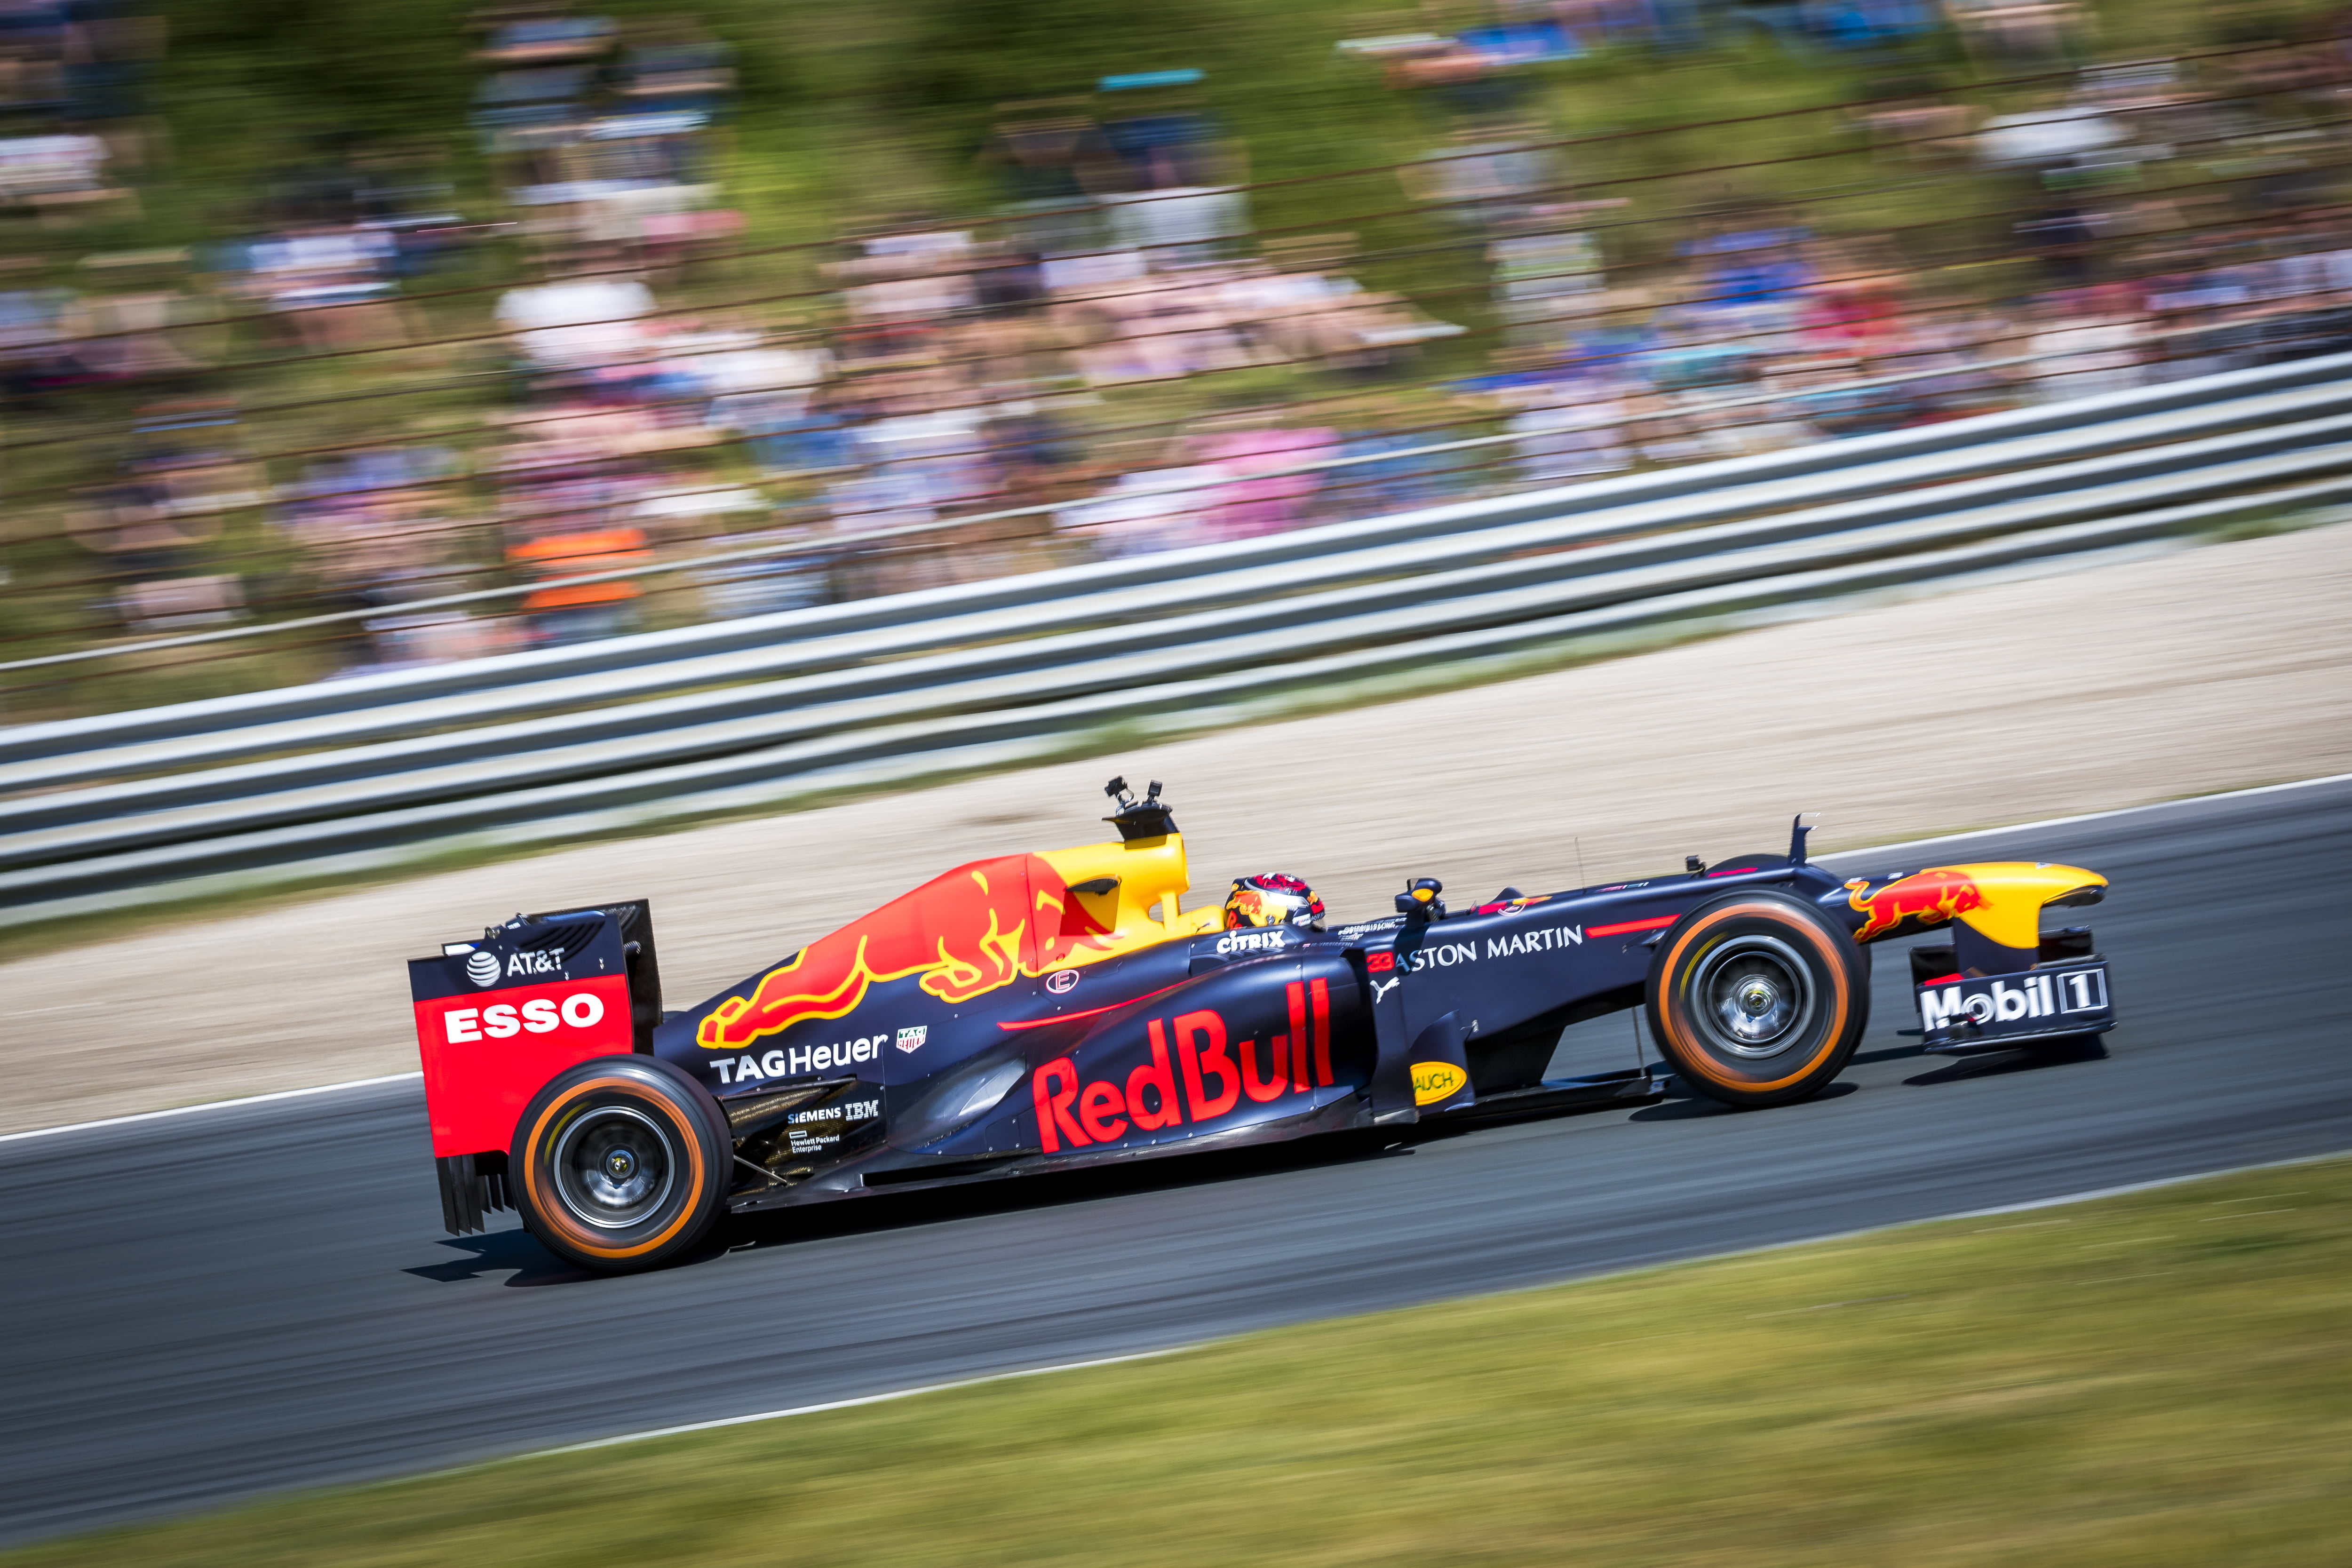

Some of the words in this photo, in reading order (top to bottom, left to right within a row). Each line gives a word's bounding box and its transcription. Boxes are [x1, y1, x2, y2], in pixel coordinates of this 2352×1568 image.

[1395, 941, 1478, 973] ASTON
[1487, 924, 1583, 959] MARTIN
[507, 947, 564, 977] AT&T
[1366, 951, 1395, 973] 33
[1920, 975, 2056, 1032] Mobil
[2069, 974, 2091, 1009] 1
[444, 993, 604, 1044] ESSO
[898, 1027, 925, 1038] TAG
[1414, 1071, 1453, 1093] AUCH
[787, 1107, 841, 1124] SIEMENS
[845, 1099, 879, 1121] IBM
[791, 1138, 815, 1147] Hewlett
[816, 1134, 840, 1144] Packard
[792, 1145, 822, 1154] Enterprise
